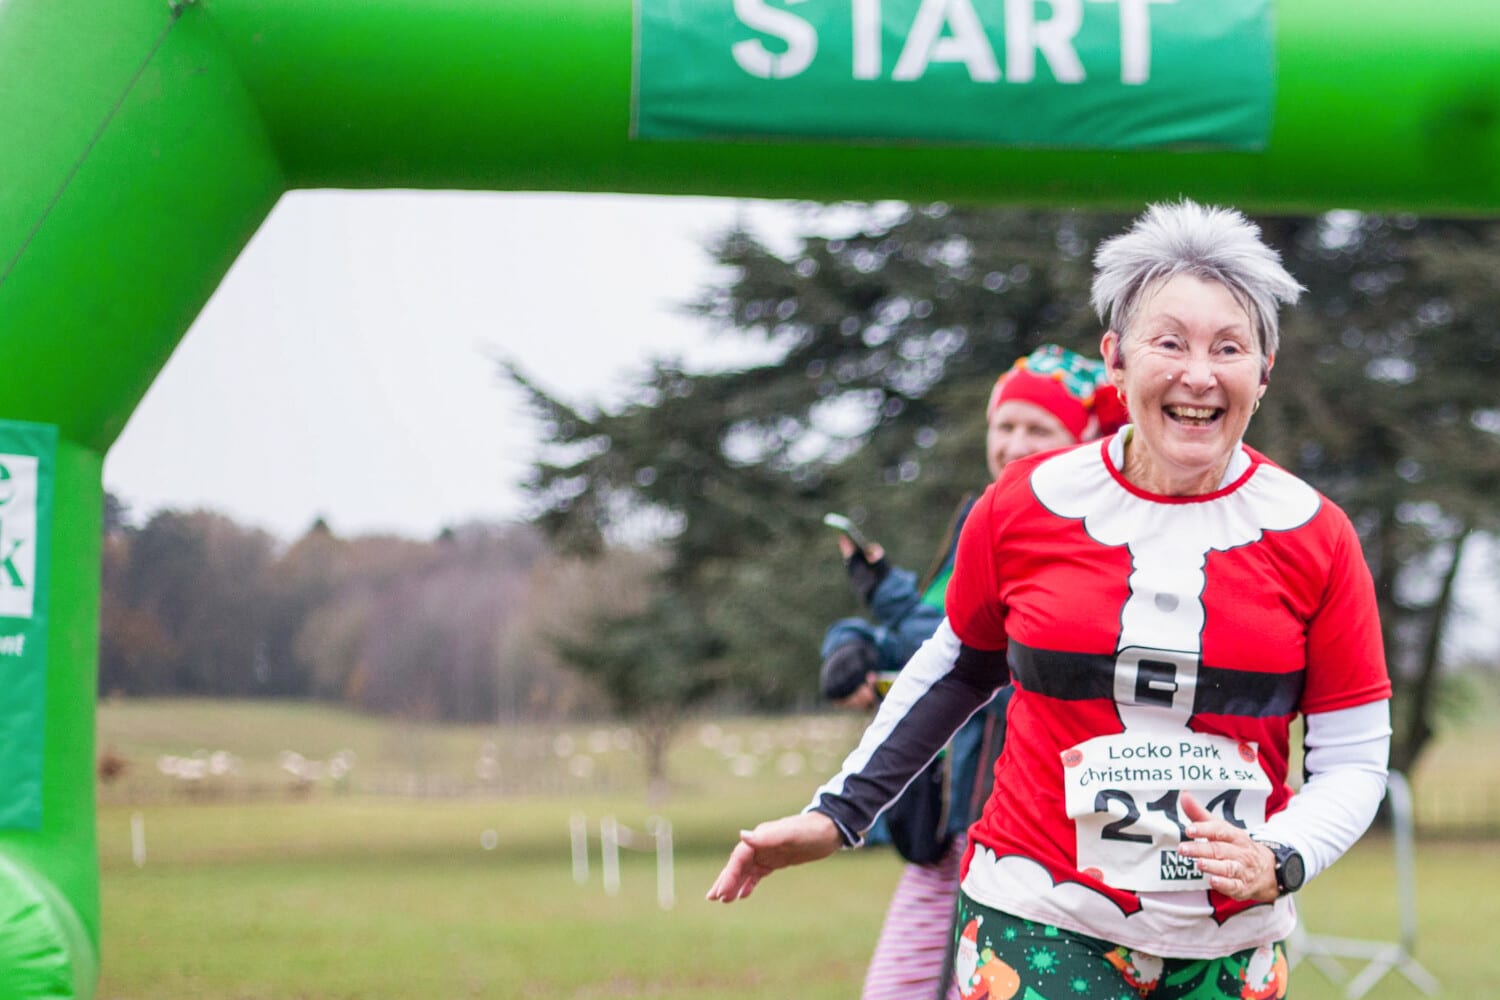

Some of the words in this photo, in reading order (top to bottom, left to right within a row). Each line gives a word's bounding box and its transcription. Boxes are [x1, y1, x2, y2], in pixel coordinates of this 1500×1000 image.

[731, 0, 1175, 85] START
[1109, 745, 1172, 760] Locko
[1179, 742, 1221, 760] Park
[1080, 766, 1173, 786] Christmas
[1180, 766, 1213, 781] 10k
[1219, 768, 1231, 780] &
